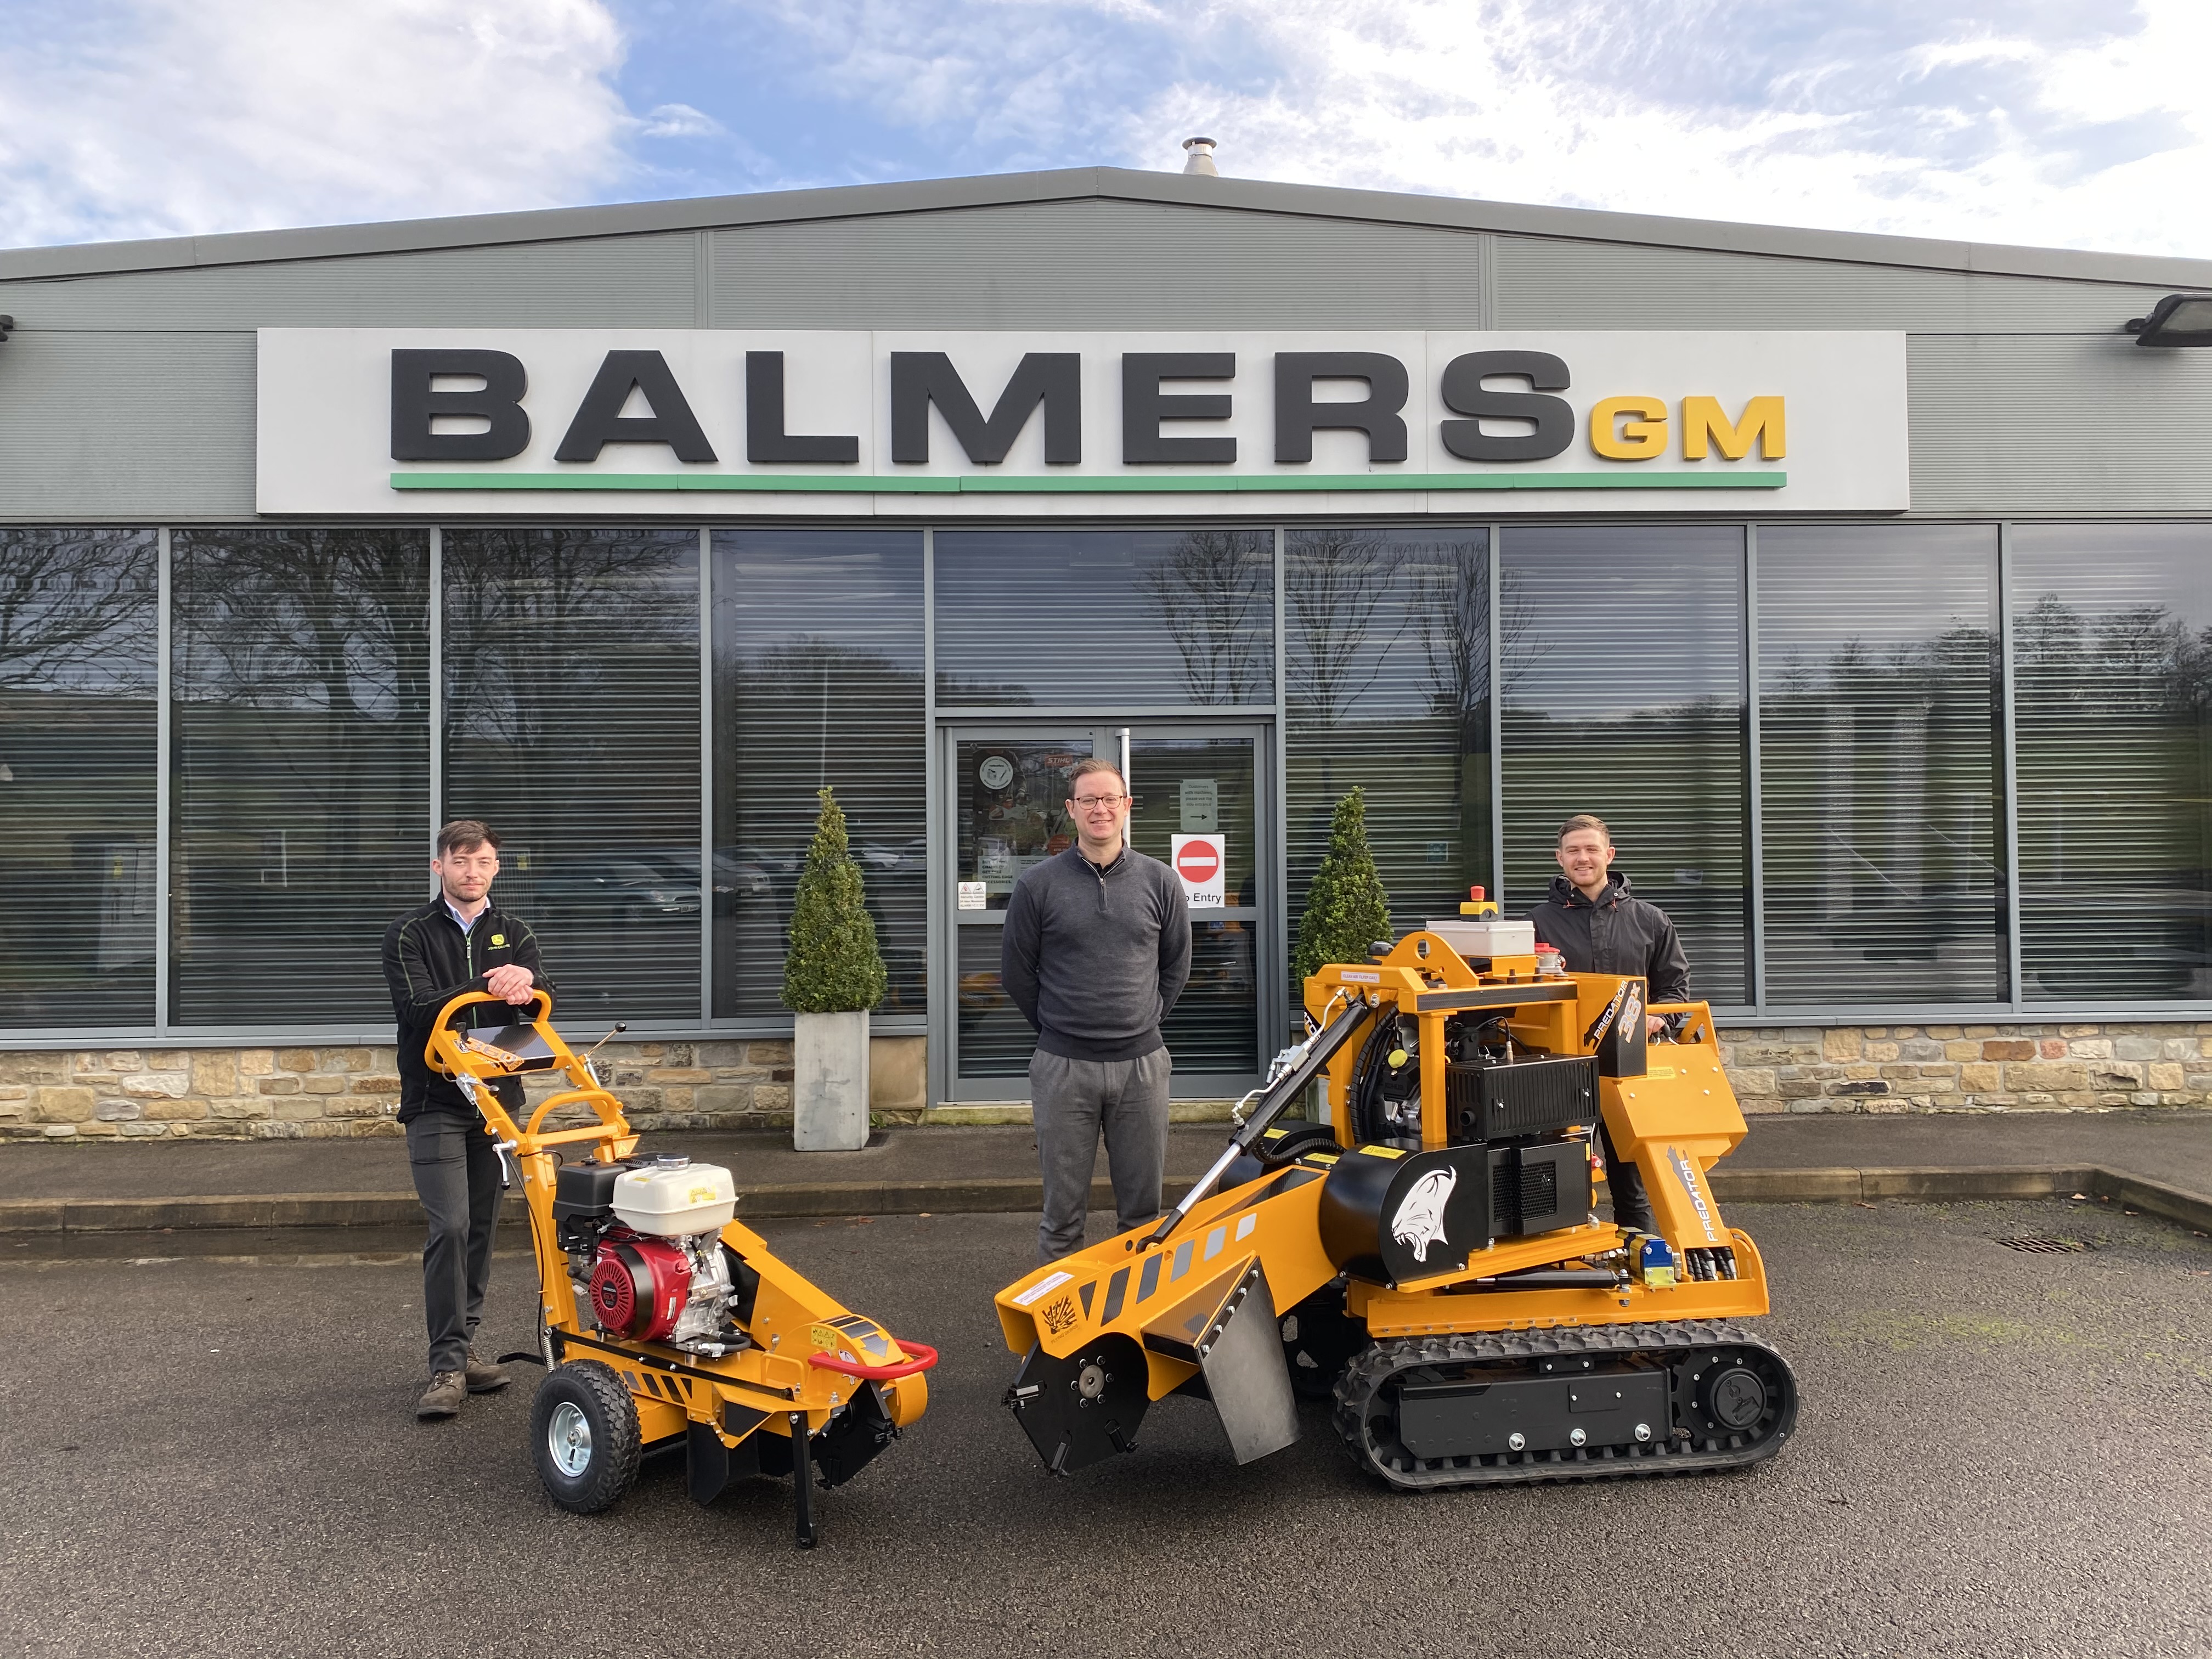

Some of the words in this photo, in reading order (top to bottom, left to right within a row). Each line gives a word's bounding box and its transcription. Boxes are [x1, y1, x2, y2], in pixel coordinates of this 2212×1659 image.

[391, 348, 1576, 464] BALMERS
[1589, 395, 1785, 461] GM
[1193, 893, 1221, 904] Entry
[1594, 980, 1628, 1040] PREDATOR
[465, 1037, 517, 1065] 360
[1679, 1159, 1719, 1242] PREDATOR
[1051, 1333, 1065, 1344] FLYING
[1064, 1324, 1079, 1335] DEBRIS
